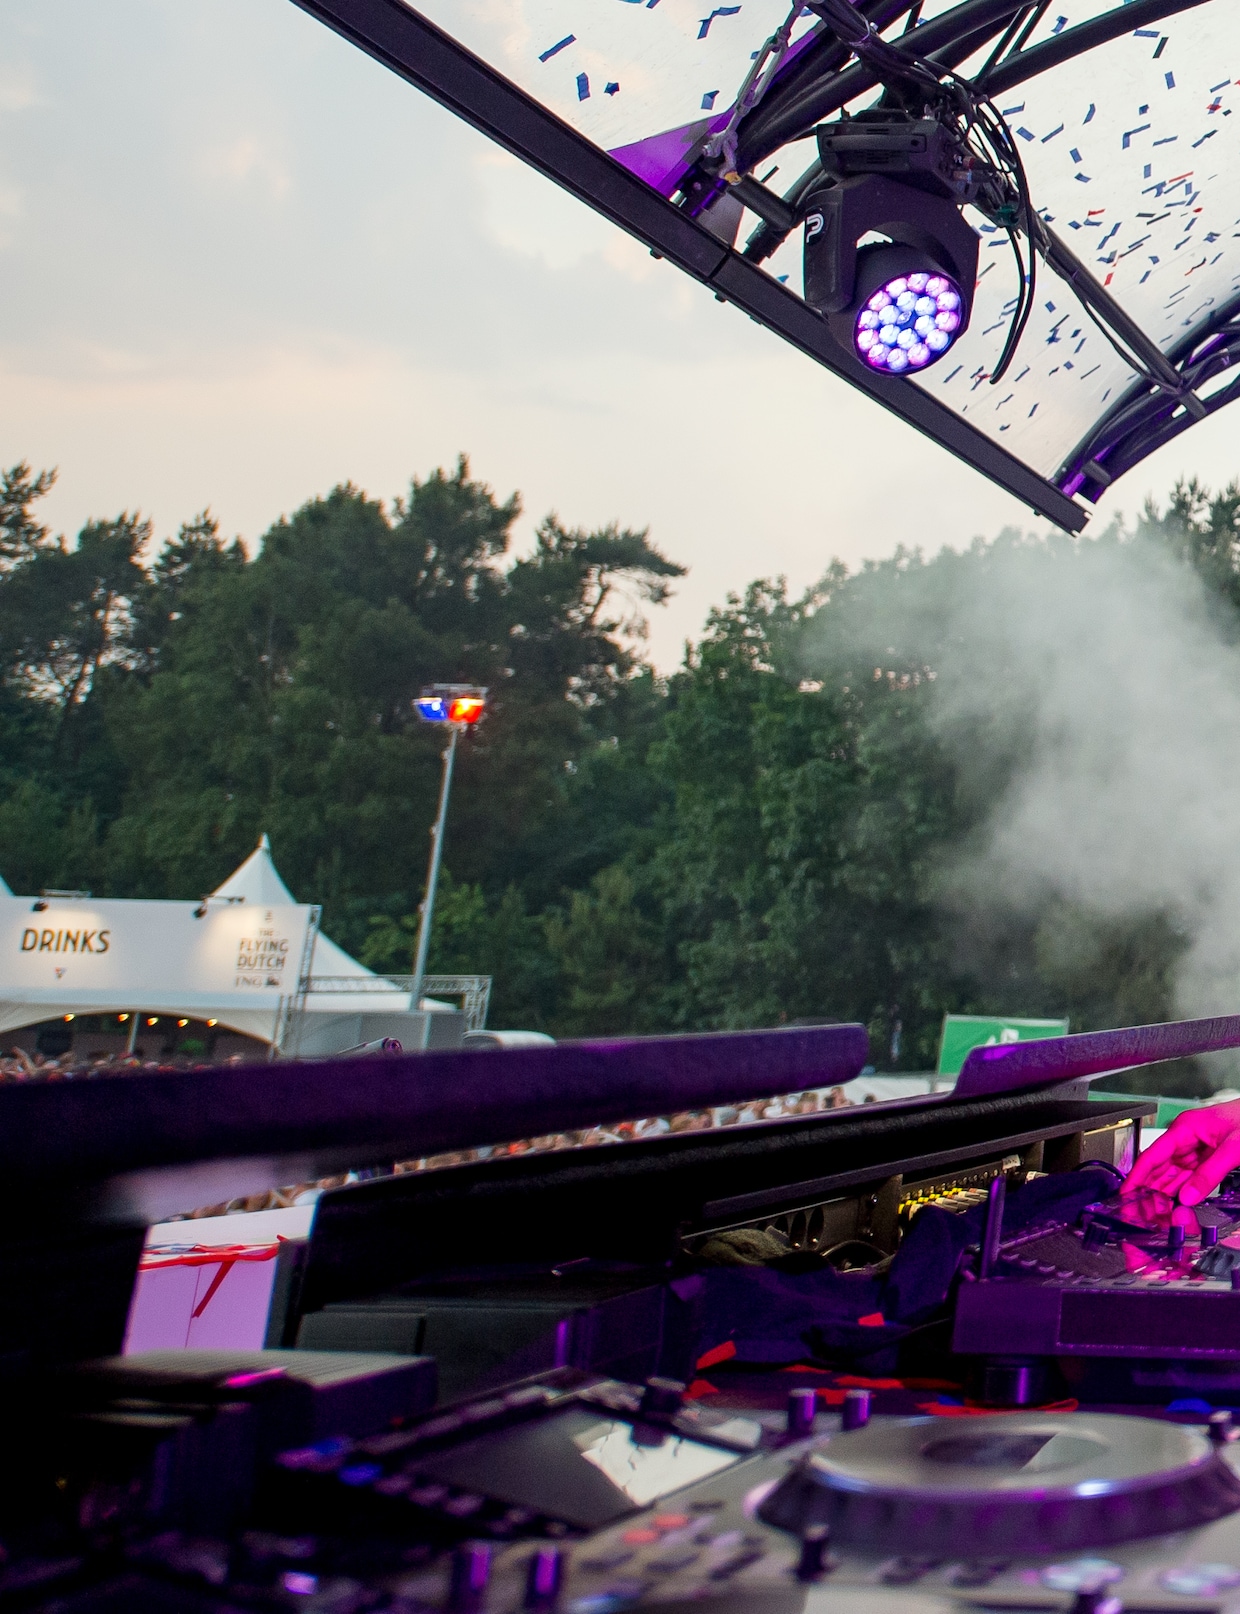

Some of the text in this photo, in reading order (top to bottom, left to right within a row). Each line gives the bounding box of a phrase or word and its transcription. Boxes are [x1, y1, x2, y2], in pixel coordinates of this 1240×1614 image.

[20, 928, 111, 954] DRINKS
[239, 937, 289, 952] FLYING
[237, 954, 286, 968] DUTCH
[235, 976, 263, 988] ING
